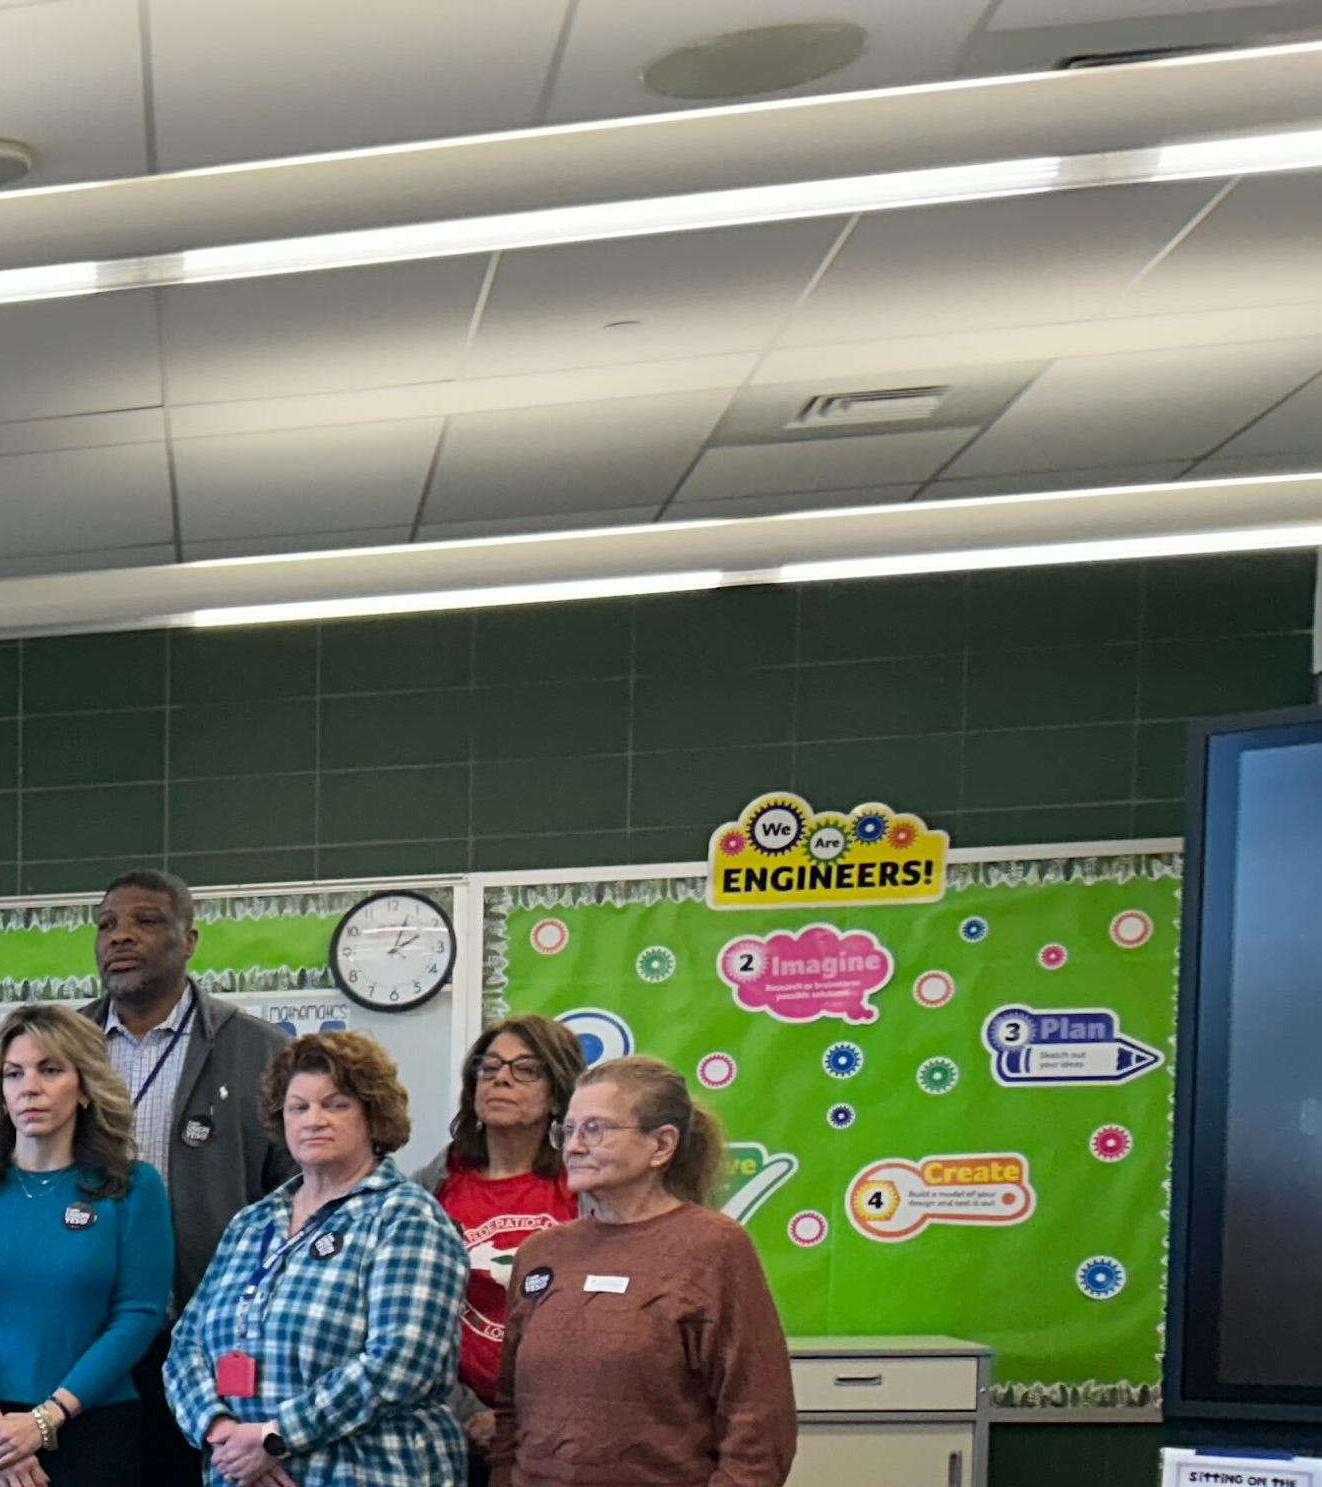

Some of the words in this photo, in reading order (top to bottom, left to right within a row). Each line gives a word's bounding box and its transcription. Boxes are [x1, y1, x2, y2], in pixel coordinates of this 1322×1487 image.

[762, 823, 791, 836] We
[814, 837, 839, 849] Are
[722, 860, 934, 893] ENGINEERS!
[739, 954, 754, 971] 2
[771, 952, 881, 978] Imagine
[1004, 1022, 1021, 1042] 3
[1040, 1017, 1106, 1040] Plan
[868, 1191, 883, 1209] 4
[924, 1161, 1020, 1184] Create
[1247, 1476, 1268, 1487] ON
